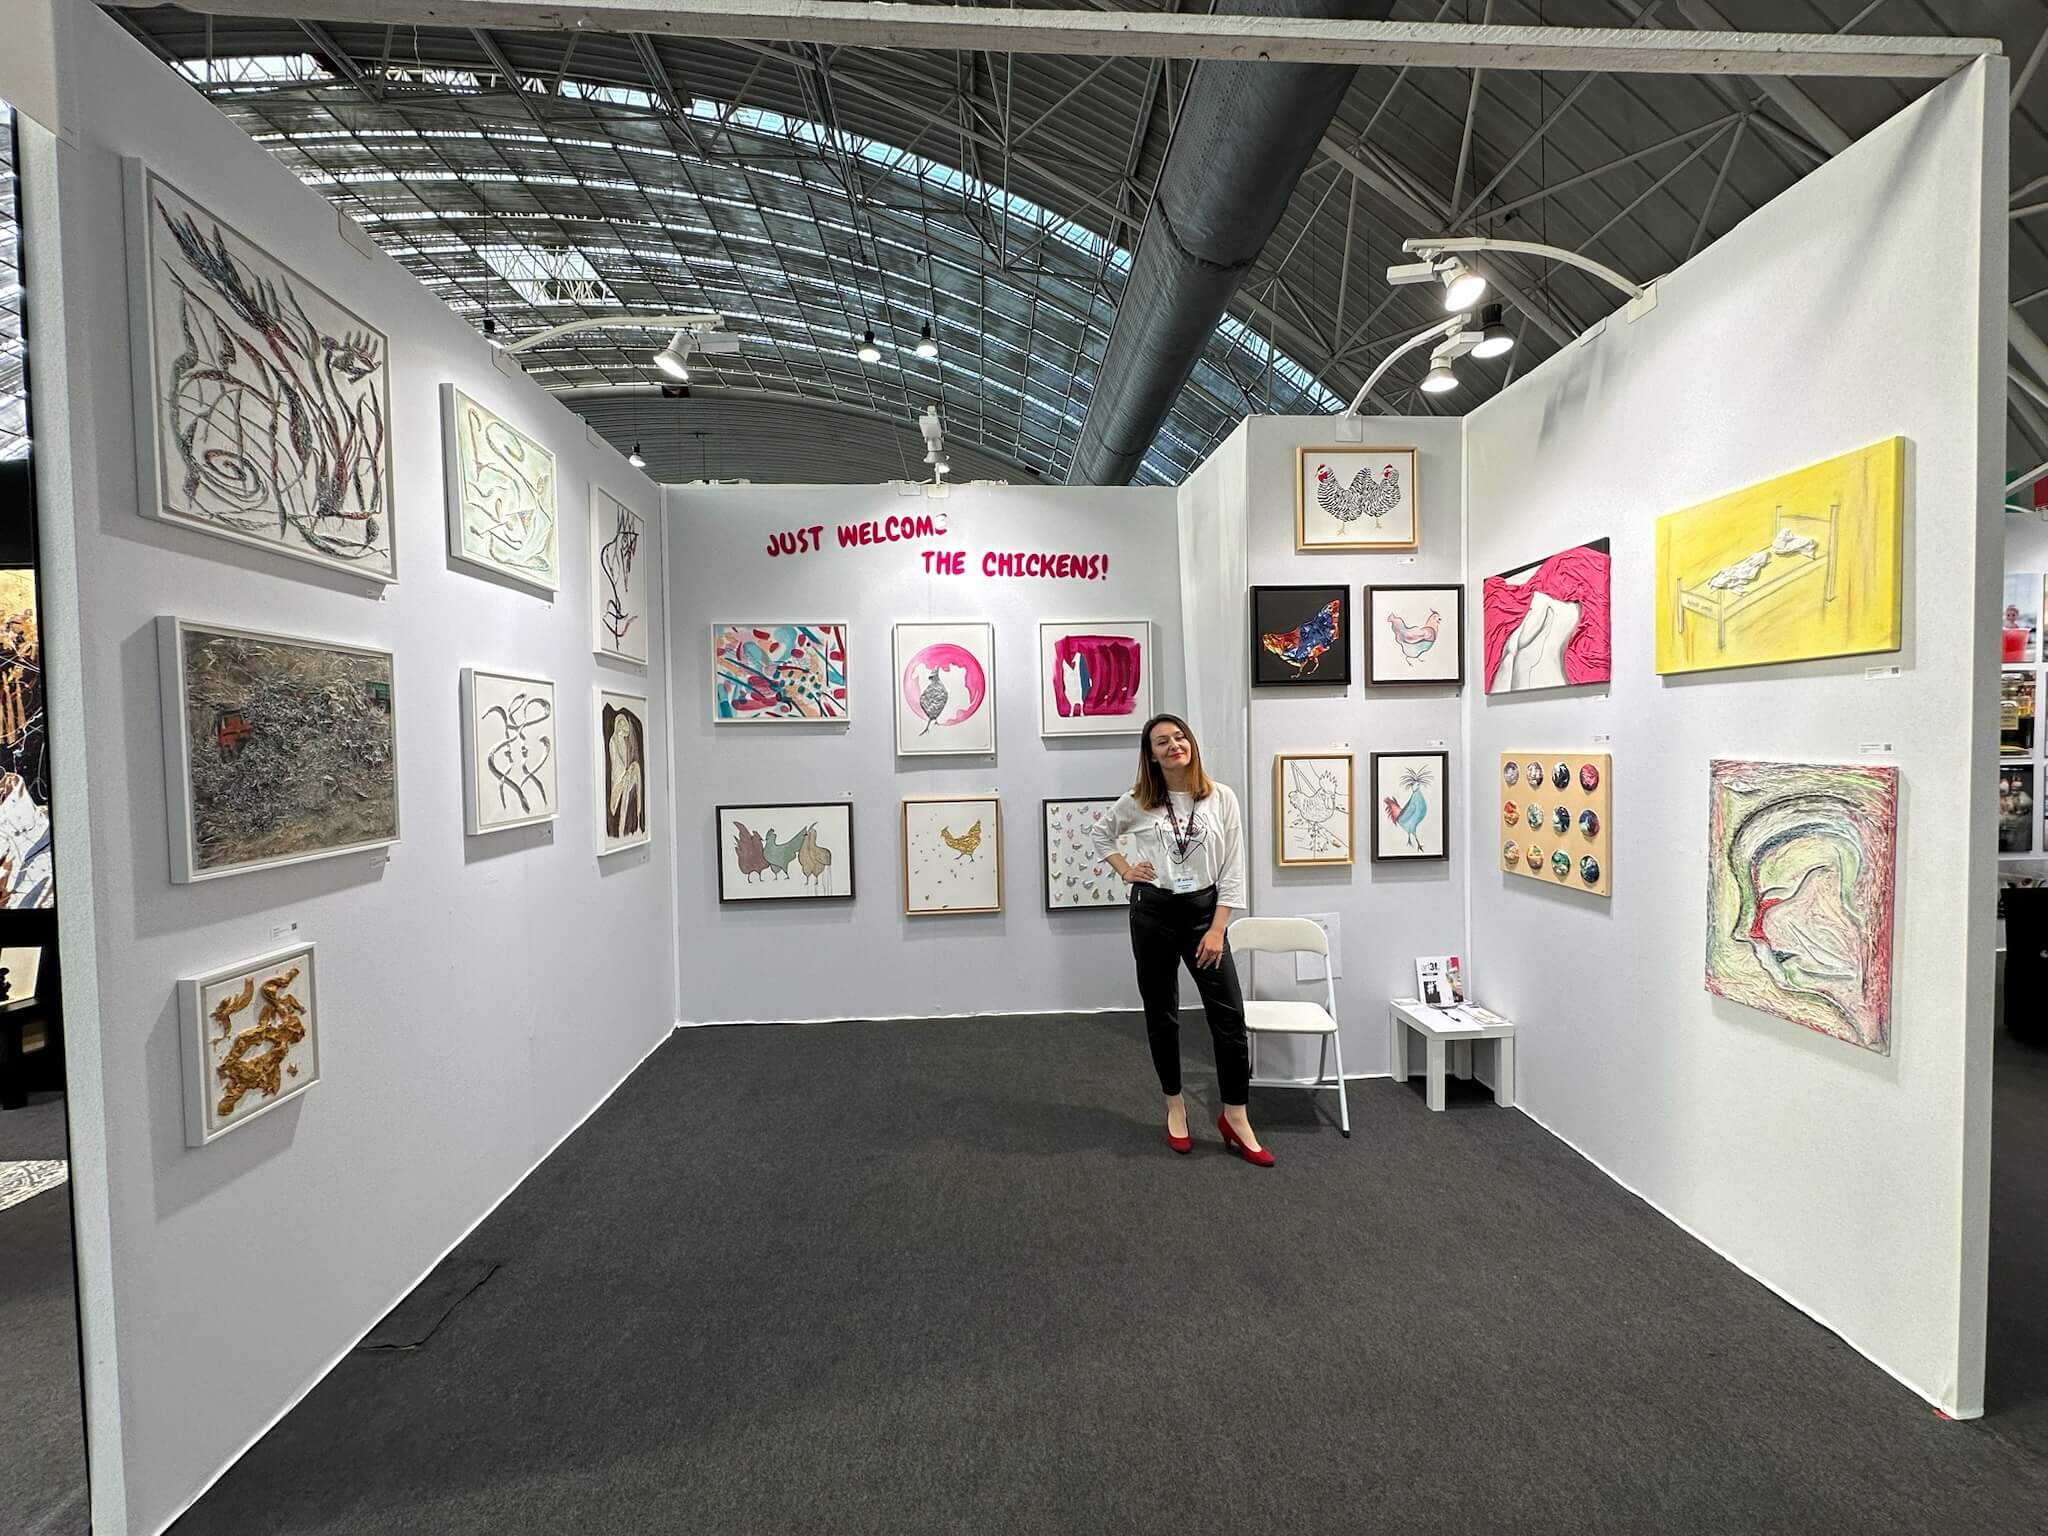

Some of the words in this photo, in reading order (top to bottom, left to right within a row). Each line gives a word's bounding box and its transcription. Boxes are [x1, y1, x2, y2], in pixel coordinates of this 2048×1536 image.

[767, 525, 824, 557] JUST
[921, 551, 966, 575] THE
[982, 551, 1109, 580] CHICKENS!
